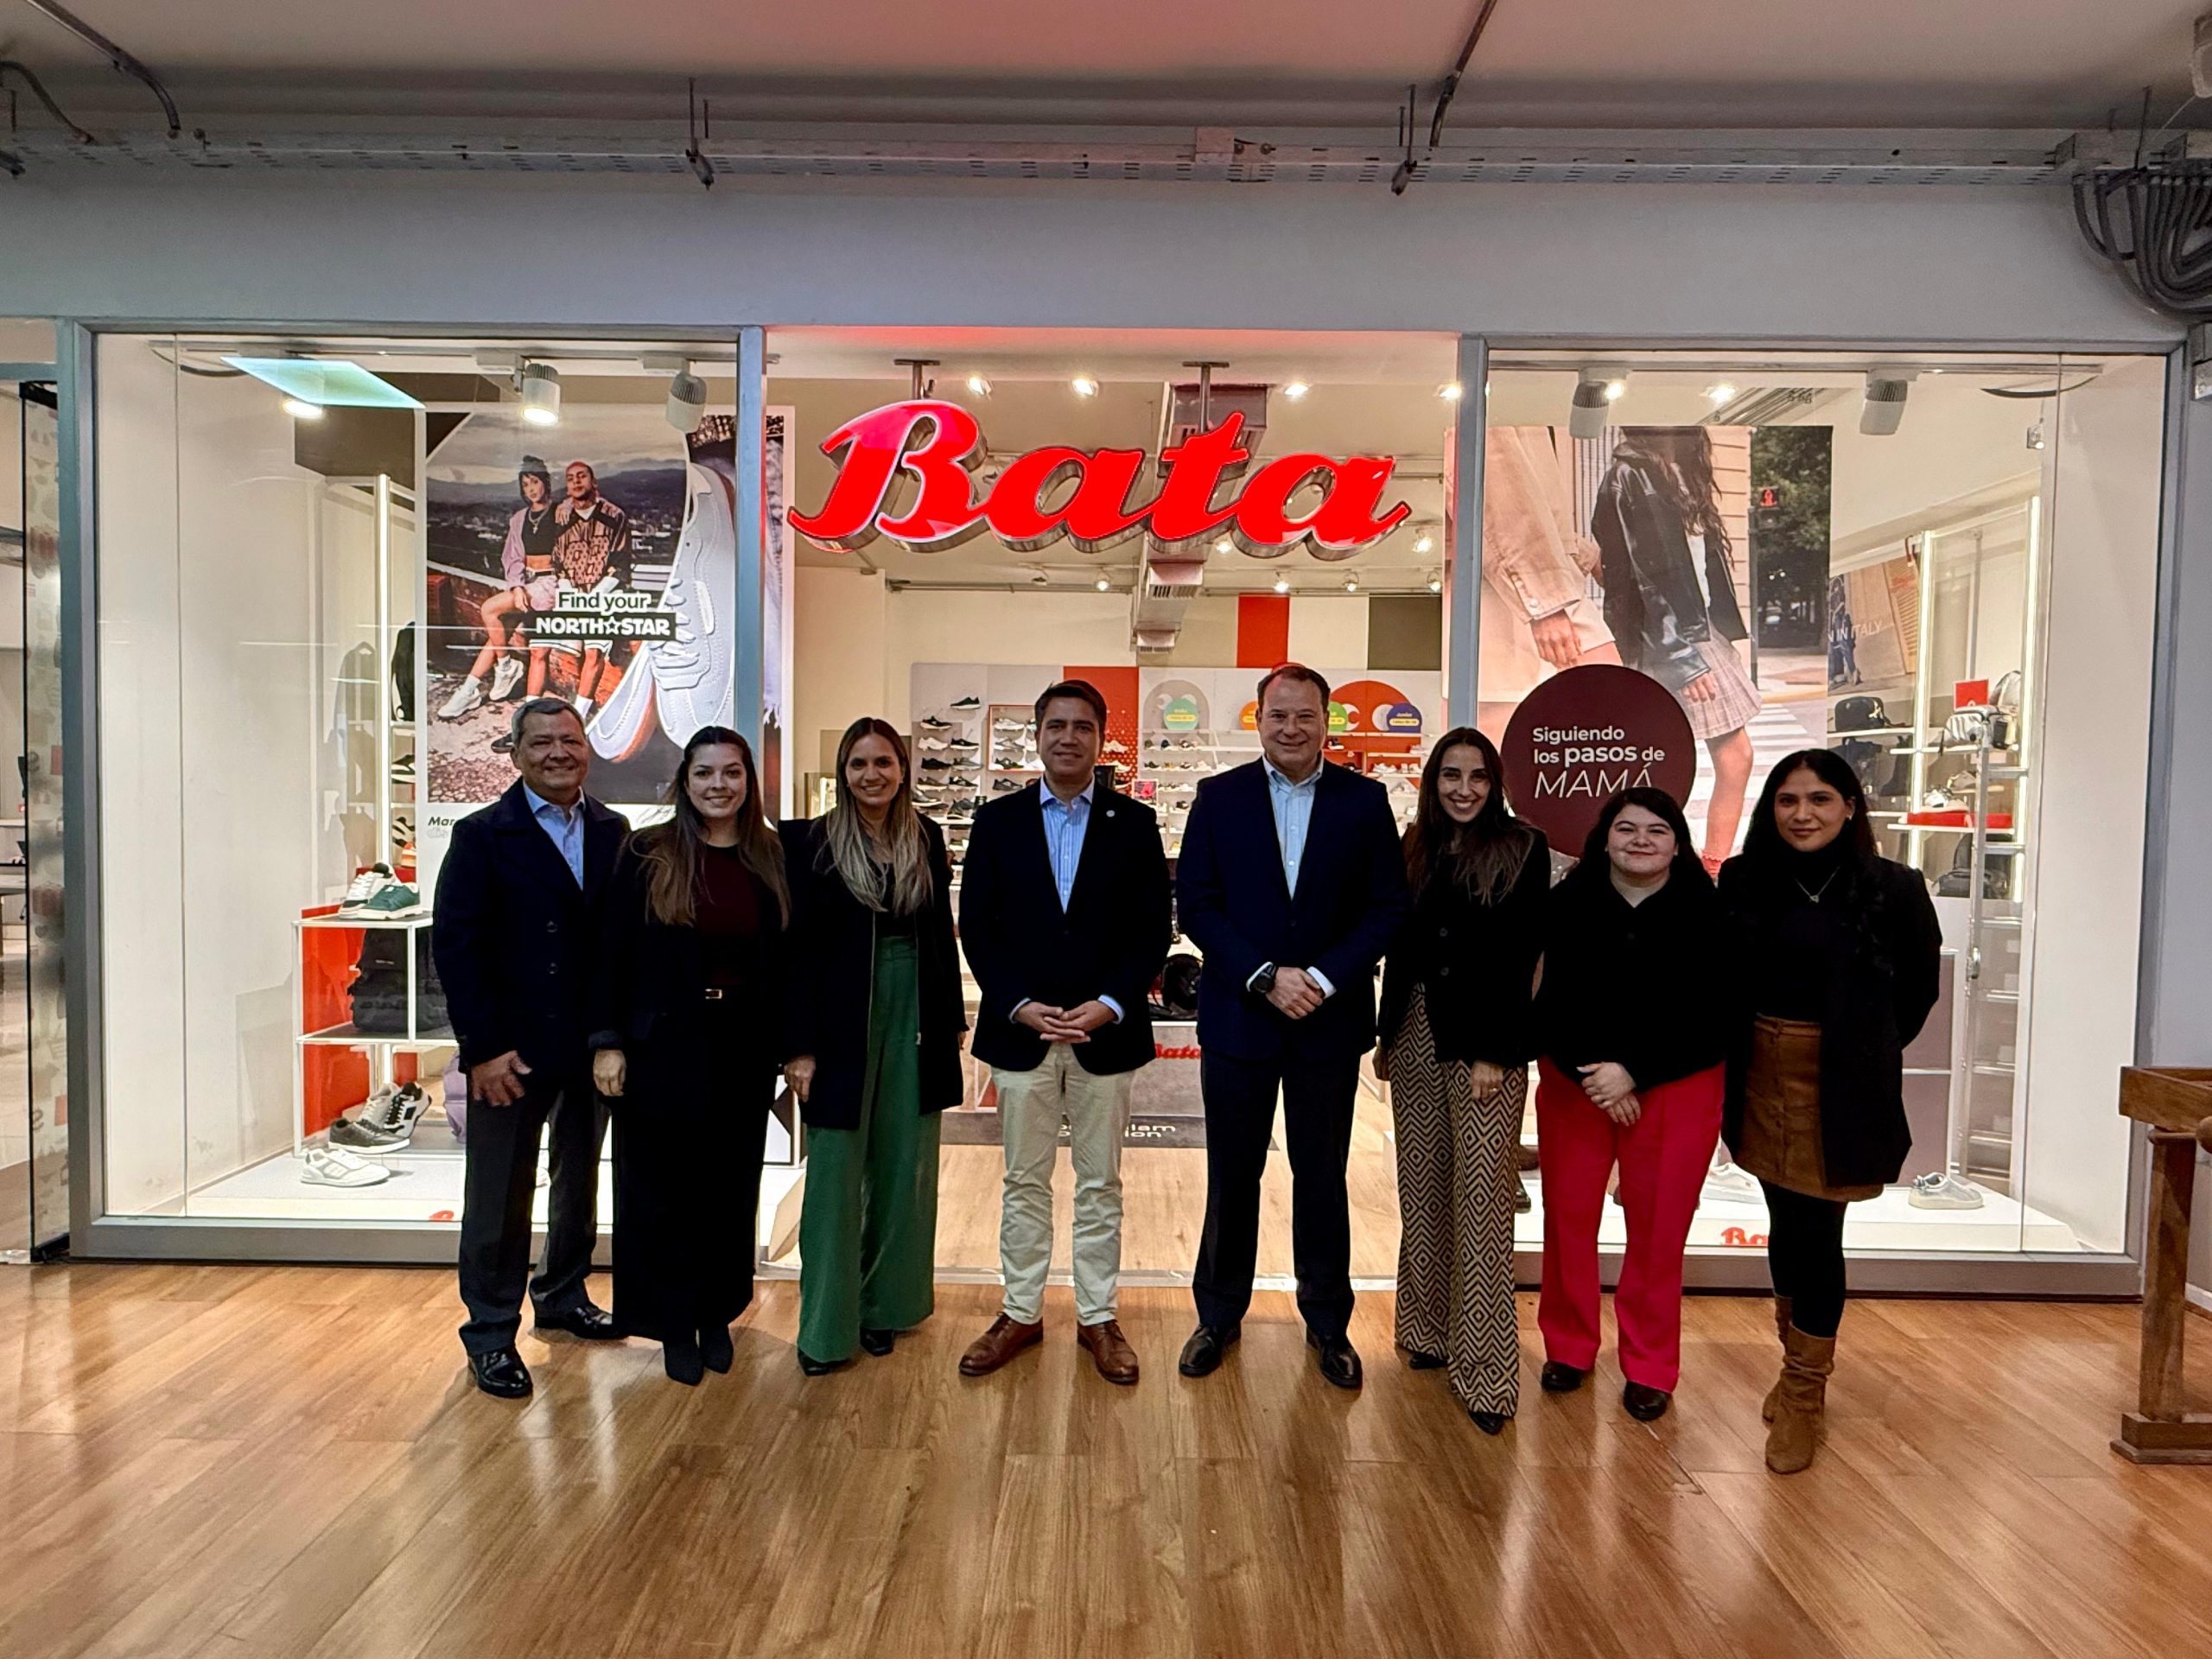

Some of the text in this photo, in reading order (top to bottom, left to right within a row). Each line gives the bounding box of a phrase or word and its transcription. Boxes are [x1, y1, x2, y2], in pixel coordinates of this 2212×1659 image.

[787, 399, 1411, 553] Bata
[559, 592, 647, 612] Find your
[536, 617, 670, 636] NORTH STAR
[1533, 725, 1625, 745] Siguiendo
[1534, 746, 1665, 767] los pasos de
[1534, 762, 1653, 798] MAMÁ
[428, 816, 456, 826] Mar
